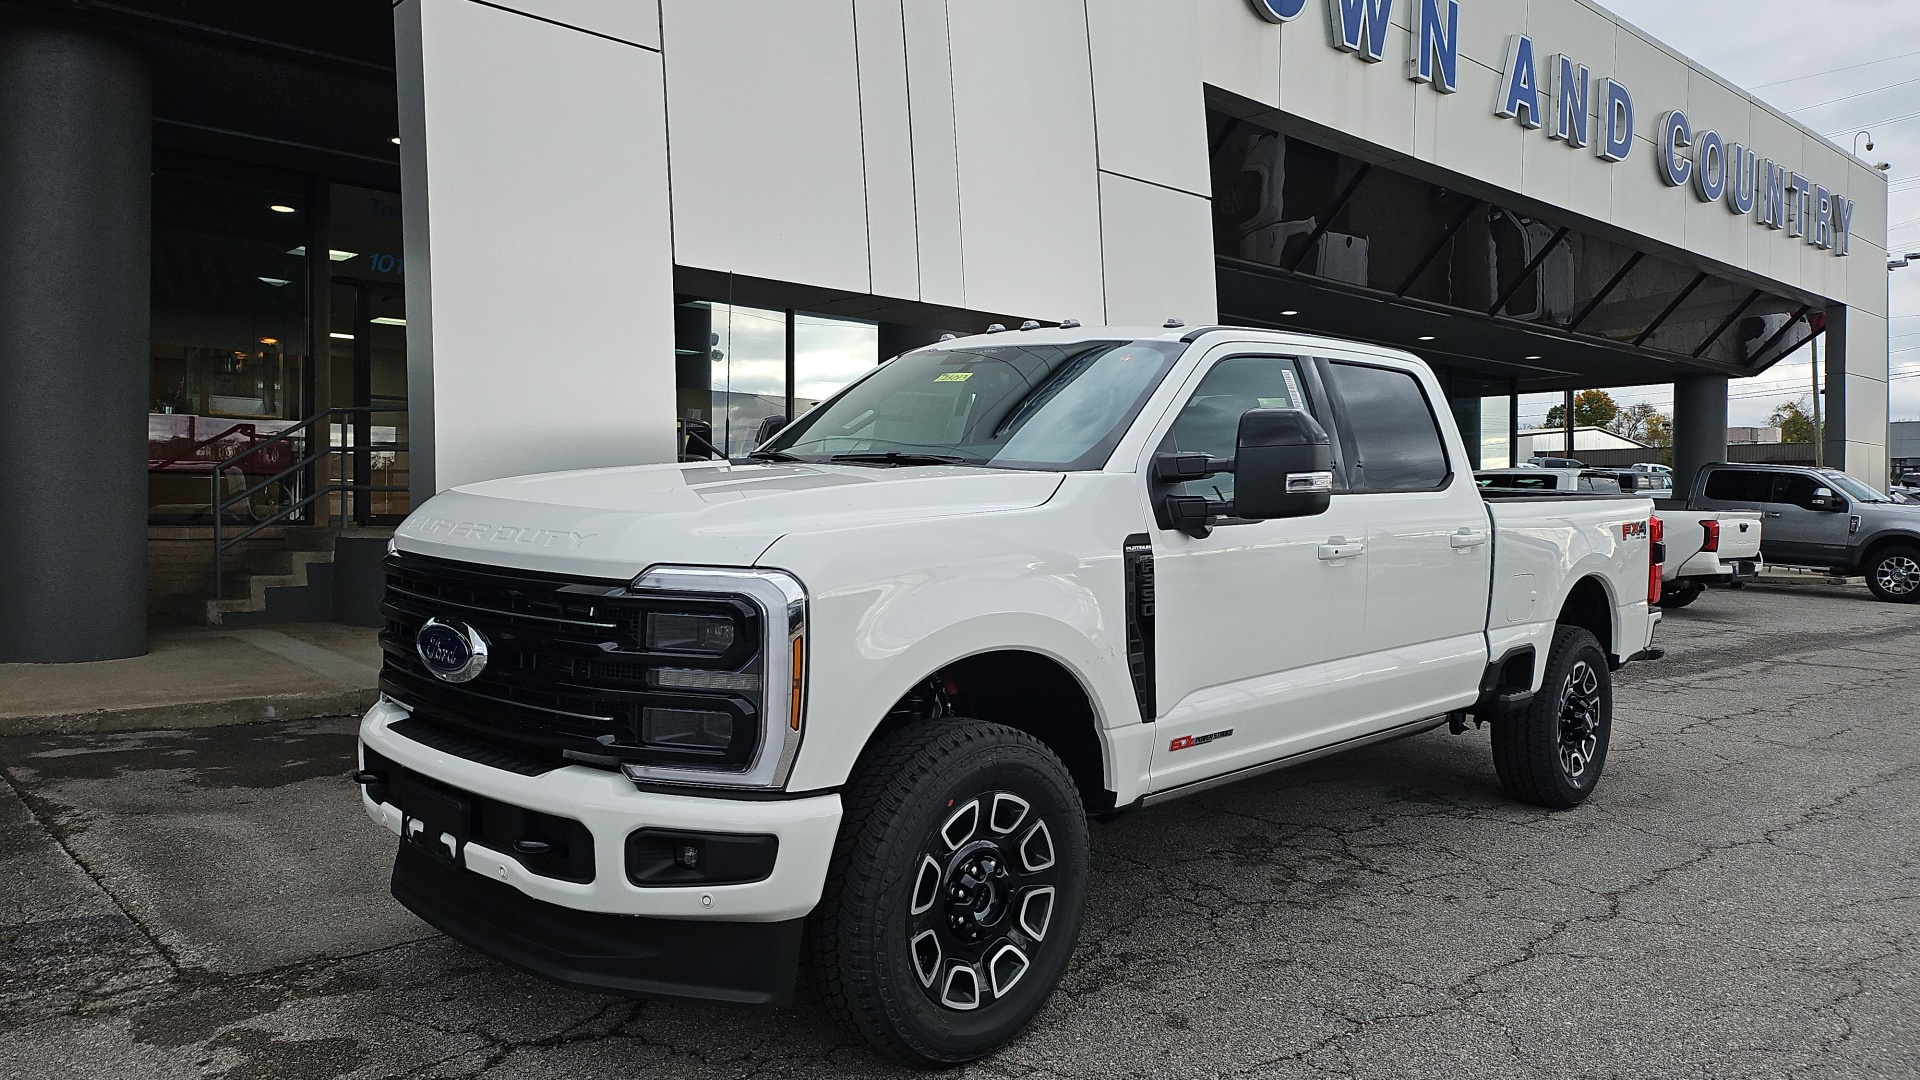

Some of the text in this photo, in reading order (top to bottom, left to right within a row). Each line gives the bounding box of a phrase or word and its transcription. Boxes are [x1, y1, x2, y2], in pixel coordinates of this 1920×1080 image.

[1252, 0, 1855, 257] WN AND COUNTRY
[407, 516, 598, 549] SUPER DUTY
[1622, 520, 1647, 541] FX4
[426, 634, 458, 665] Ford
